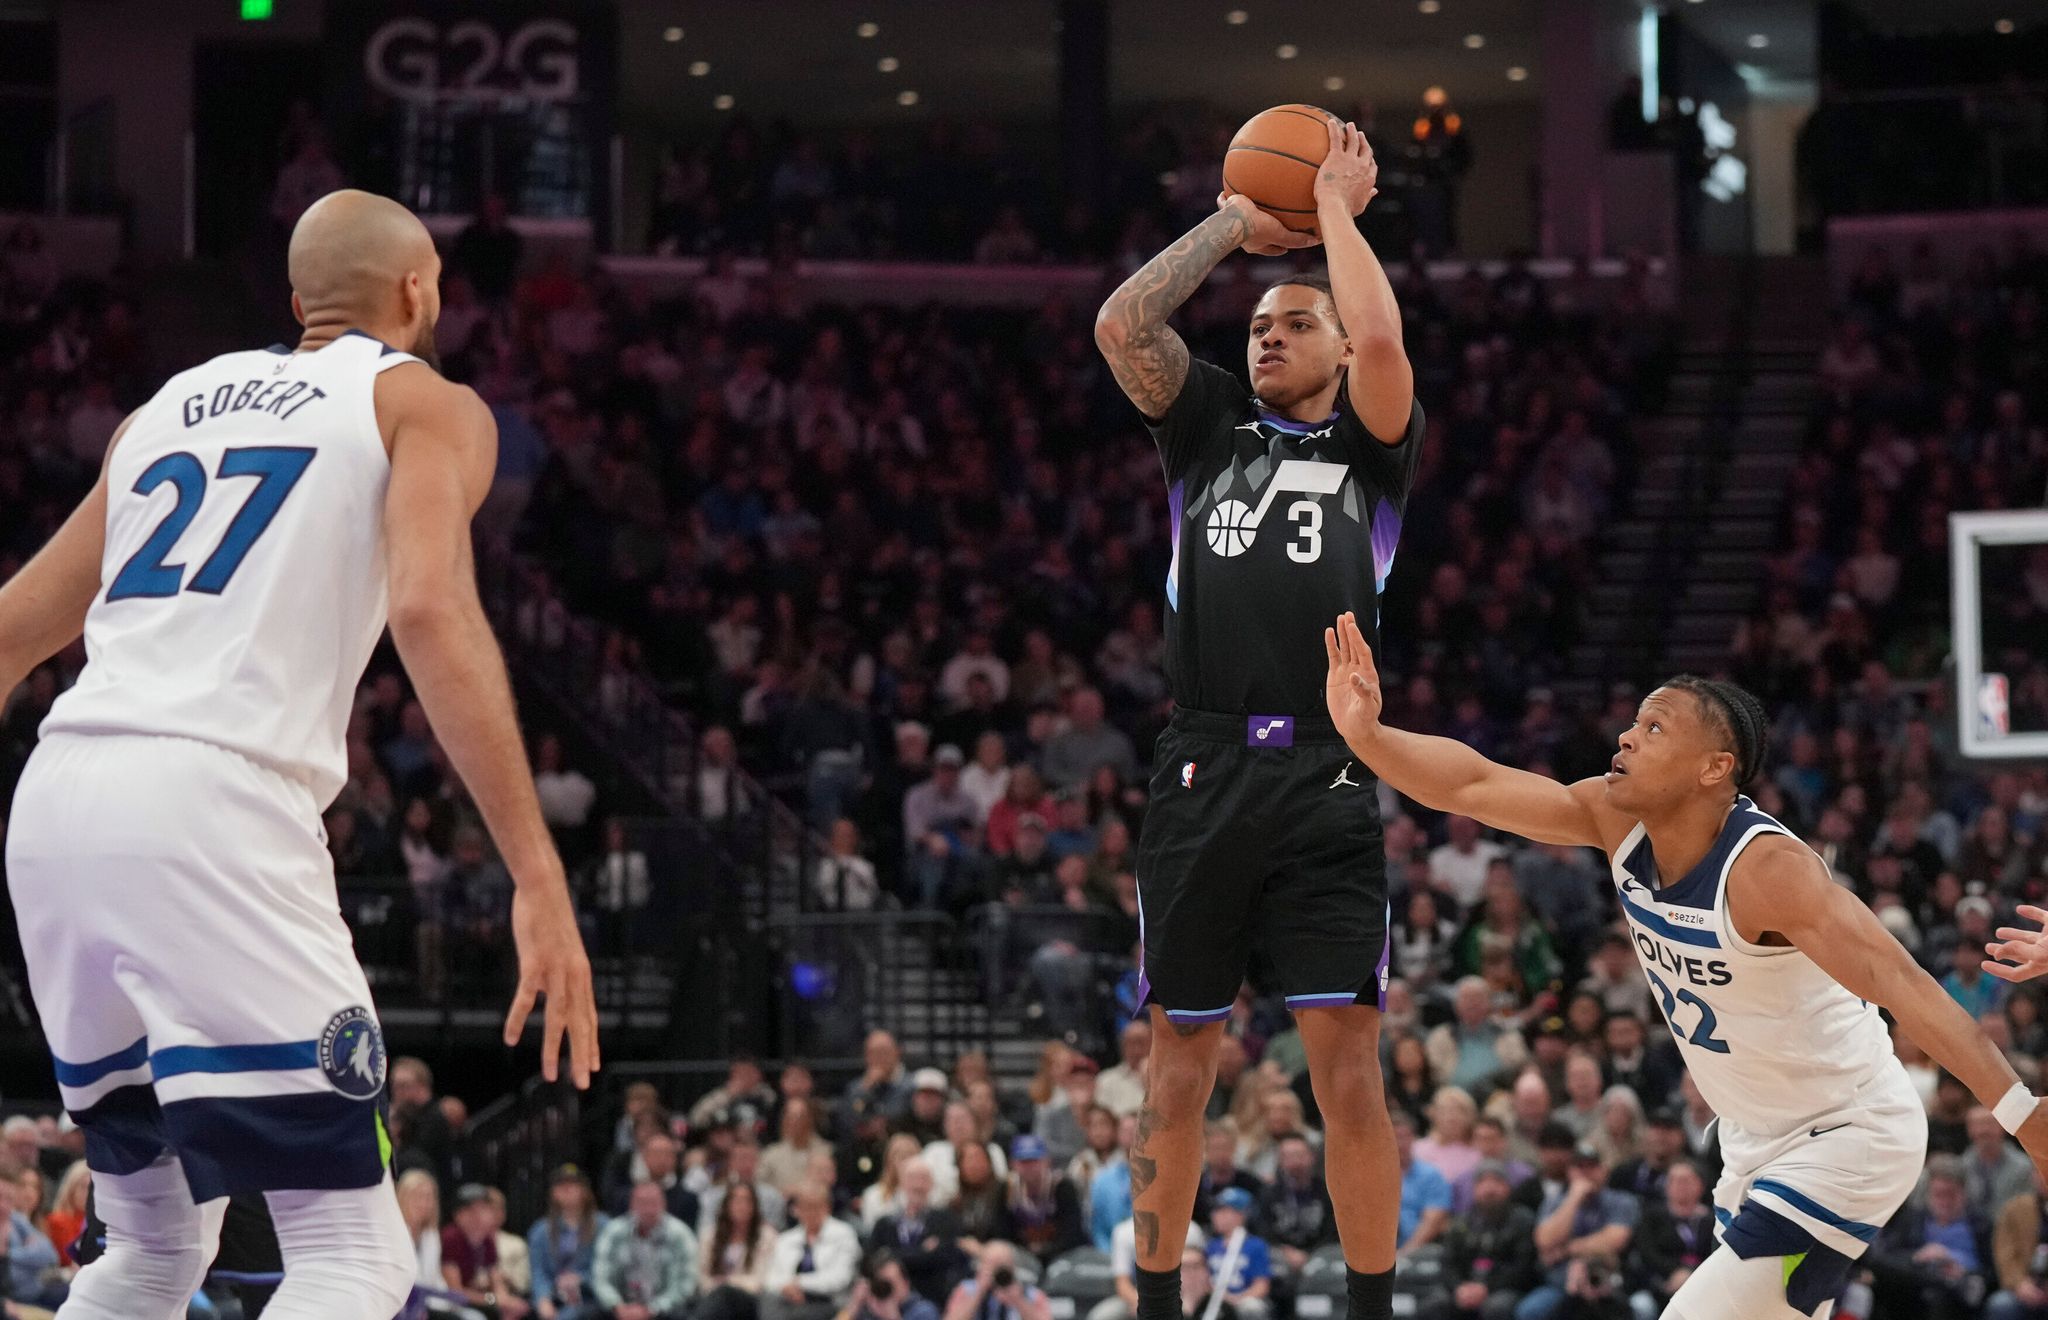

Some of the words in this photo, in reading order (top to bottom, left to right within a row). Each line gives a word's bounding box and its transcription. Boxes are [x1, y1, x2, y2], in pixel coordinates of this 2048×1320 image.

[364, 17, 578, 100] G2G
[183, 380, 327, 428] GOBERT
[105, 446, 319, 604] 27
[1286, 500, 1323, 564] 3
[1674, 911, 1705, 925] sezzle
[1629, 926, 1733, 987] OLVES
[1646, 967, 1731, 1054] 22
